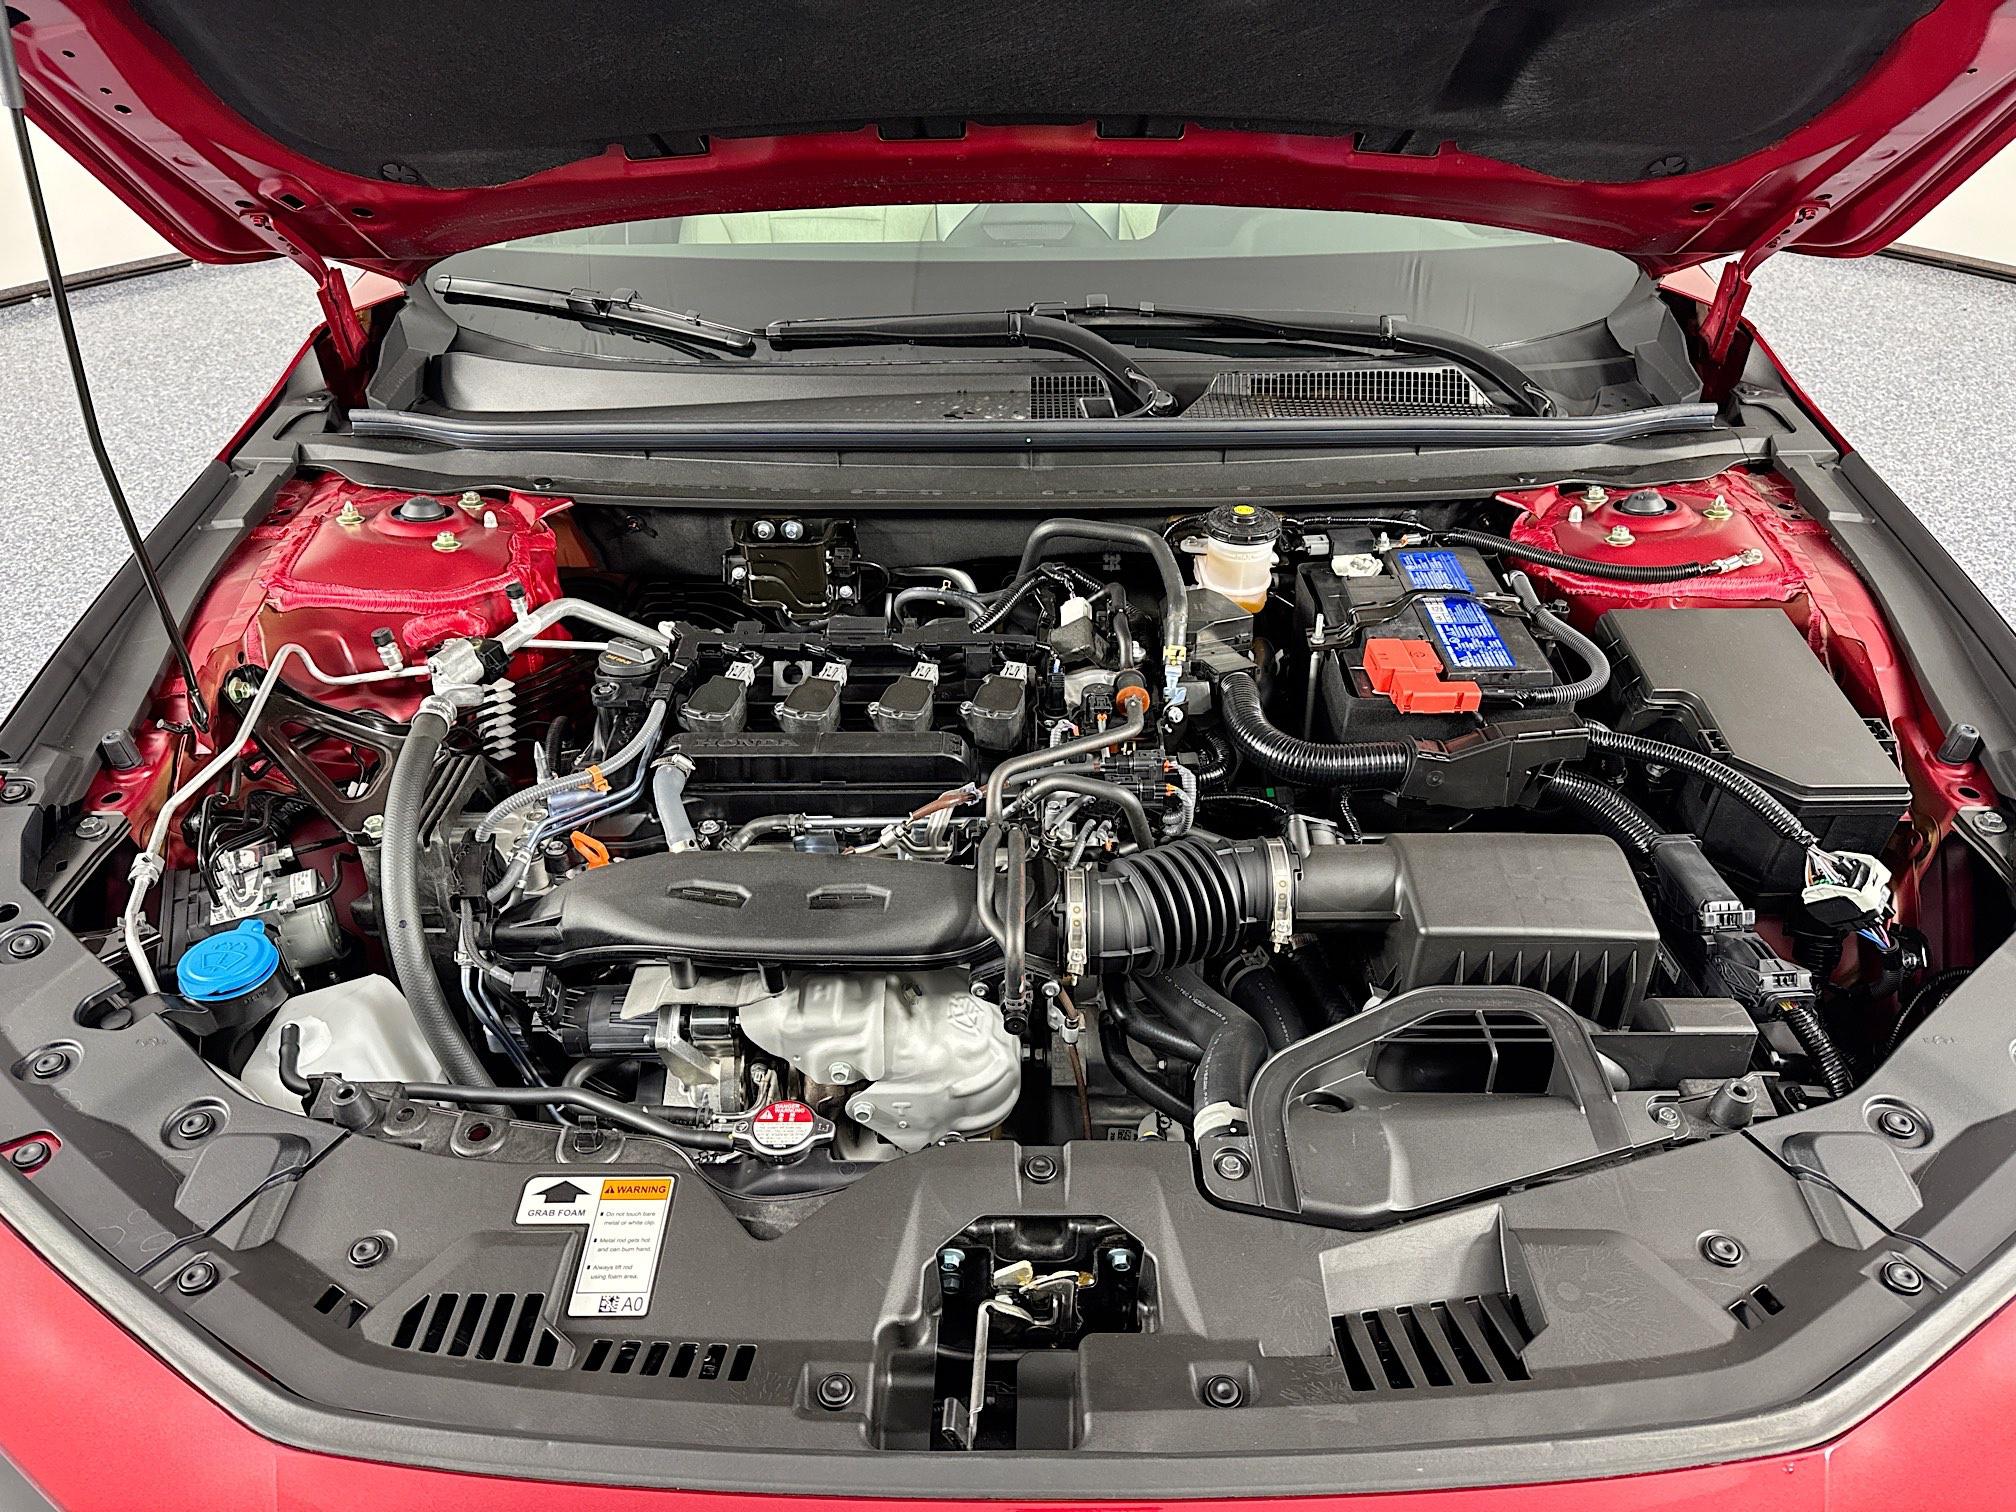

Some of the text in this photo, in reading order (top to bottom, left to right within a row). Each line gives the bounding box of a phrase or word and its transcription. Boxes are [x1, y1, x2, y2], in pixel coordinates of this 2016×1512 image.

[695, 738, 800, 748] HONDA
[617, 1185, 666, 1194] WARNING
[527, 1209, 586, 1217] GRAB FOAM
